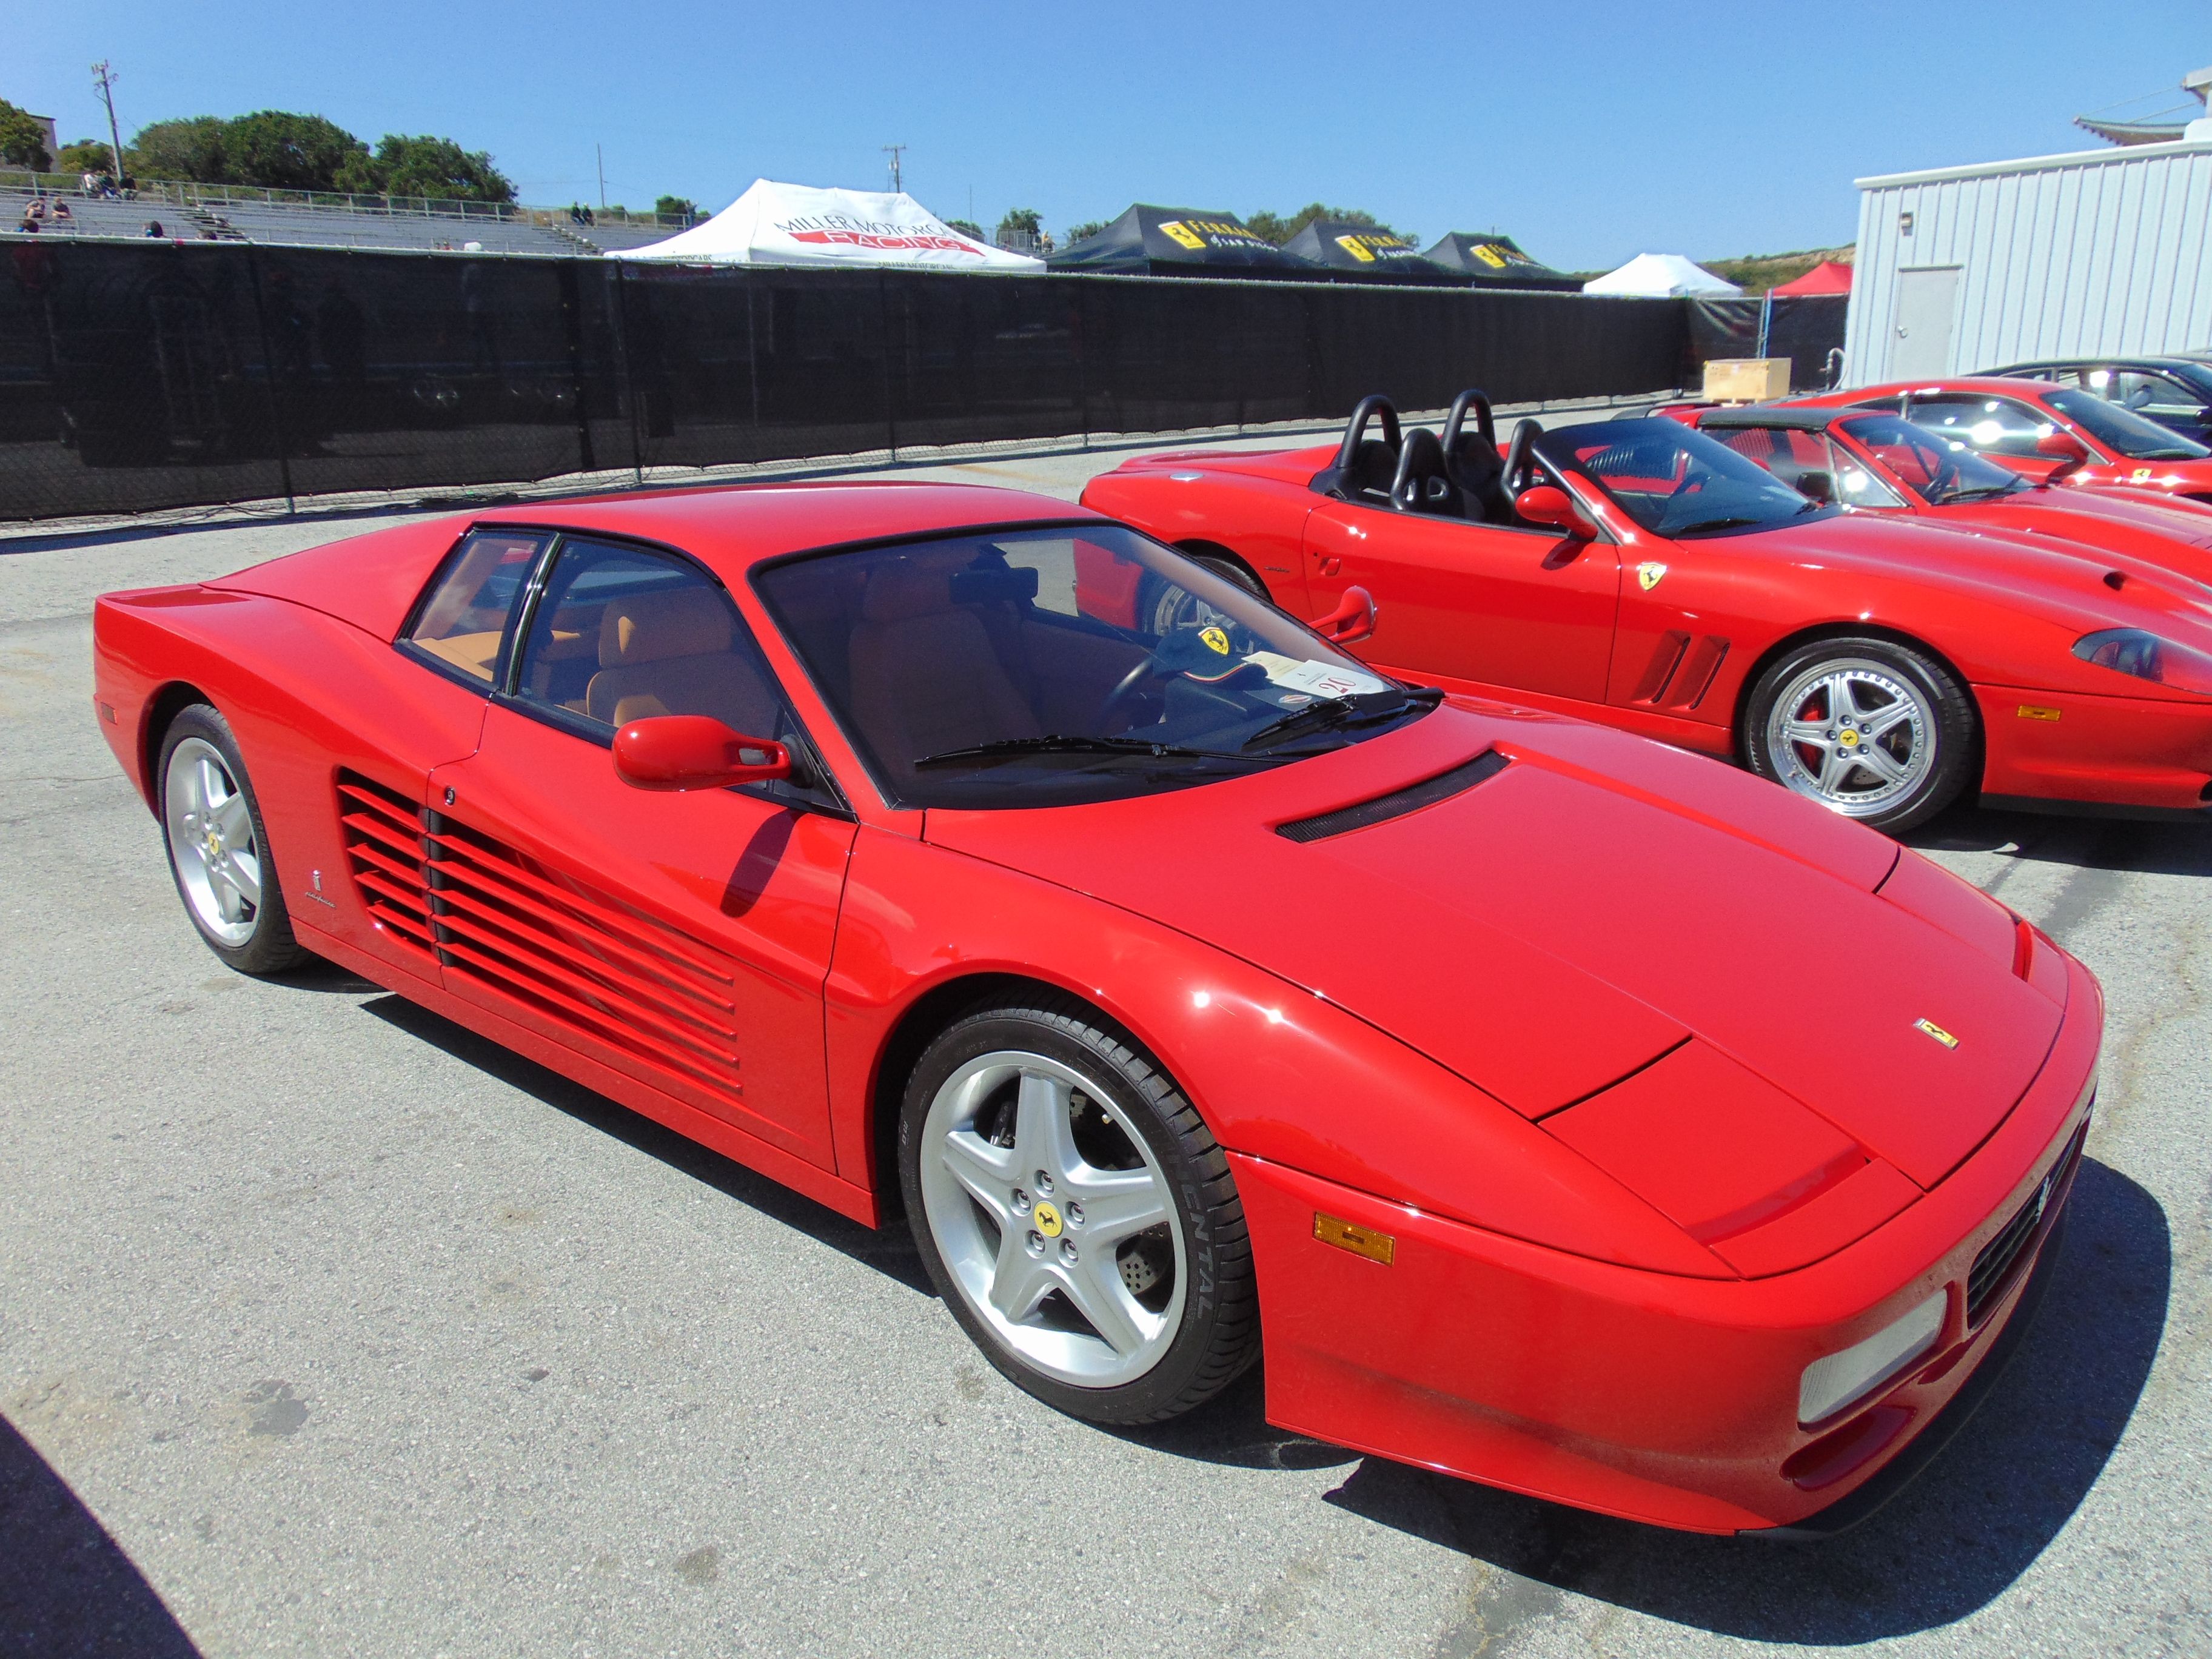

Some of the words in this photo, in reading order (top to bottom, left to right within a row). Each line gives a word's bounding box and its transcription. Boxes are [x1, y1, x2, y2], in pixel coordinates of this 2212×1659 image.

[774, 215, 855, 231] MILLER
[854, 218, 958, 238] MOTORCA
[823, 230, 961, 249] RACING
[1319, 677, 1356, 694] 20
